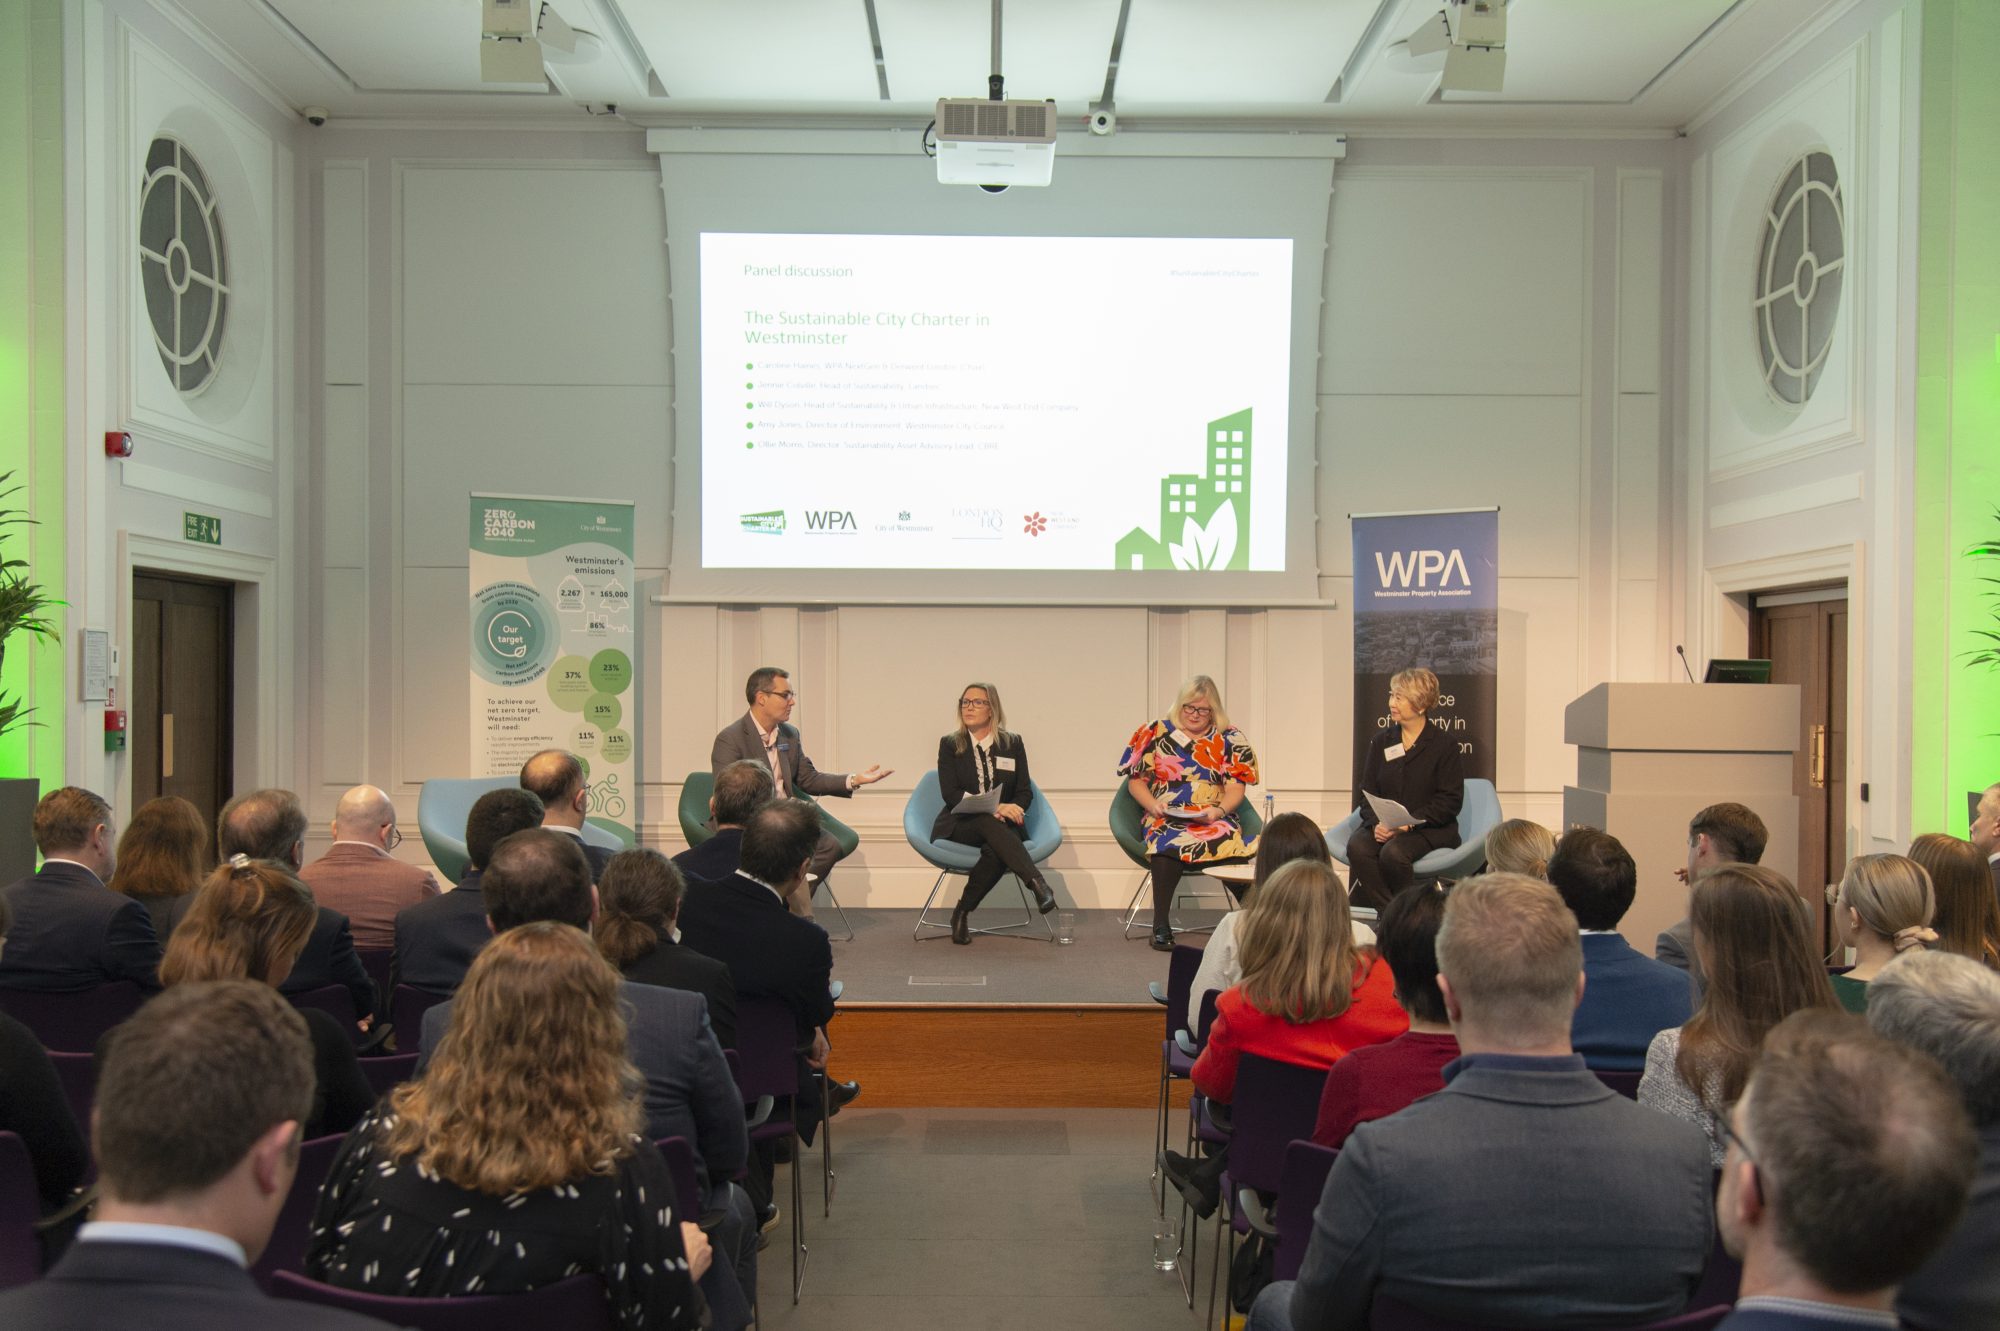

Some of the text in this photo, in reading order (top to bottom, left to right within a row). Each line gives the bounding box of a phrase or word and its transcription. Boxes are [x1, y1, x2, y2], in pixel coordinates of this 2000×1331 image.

[744, 264, 853, 278] Panel discussion
[745, 310, 989, 329] The Sustainable City Charter in
[745, 330, 848, 345] Westminster
[484, 509, 516, 519] ZERO
[187, 515, 198, 527] FIRE
[484, 519, 536, 530] CARBON
[805, 511, 858, 530] WPA
[188, 527, 198, 538] EXIT
[485, 528, 515, 537] 2040
[566, 556, 624, 566] Westminster's
[575, 567, 615, 575] emissions
[1375, 549, 1471, 588] WPA
[600, 591, 629, 599] 165,000
[1411, 589, 1436, 598] Property
[1437, 589, 1471, 597] Association
[503, 625, 518, 633] Our
[498, 636, 524, 646] target
[565, 672, 581, 680] 37%
[517, 707, 540, 715] target,
[1454, 715, 1466, 731] in
[608, 735, 624, 743] 11%
